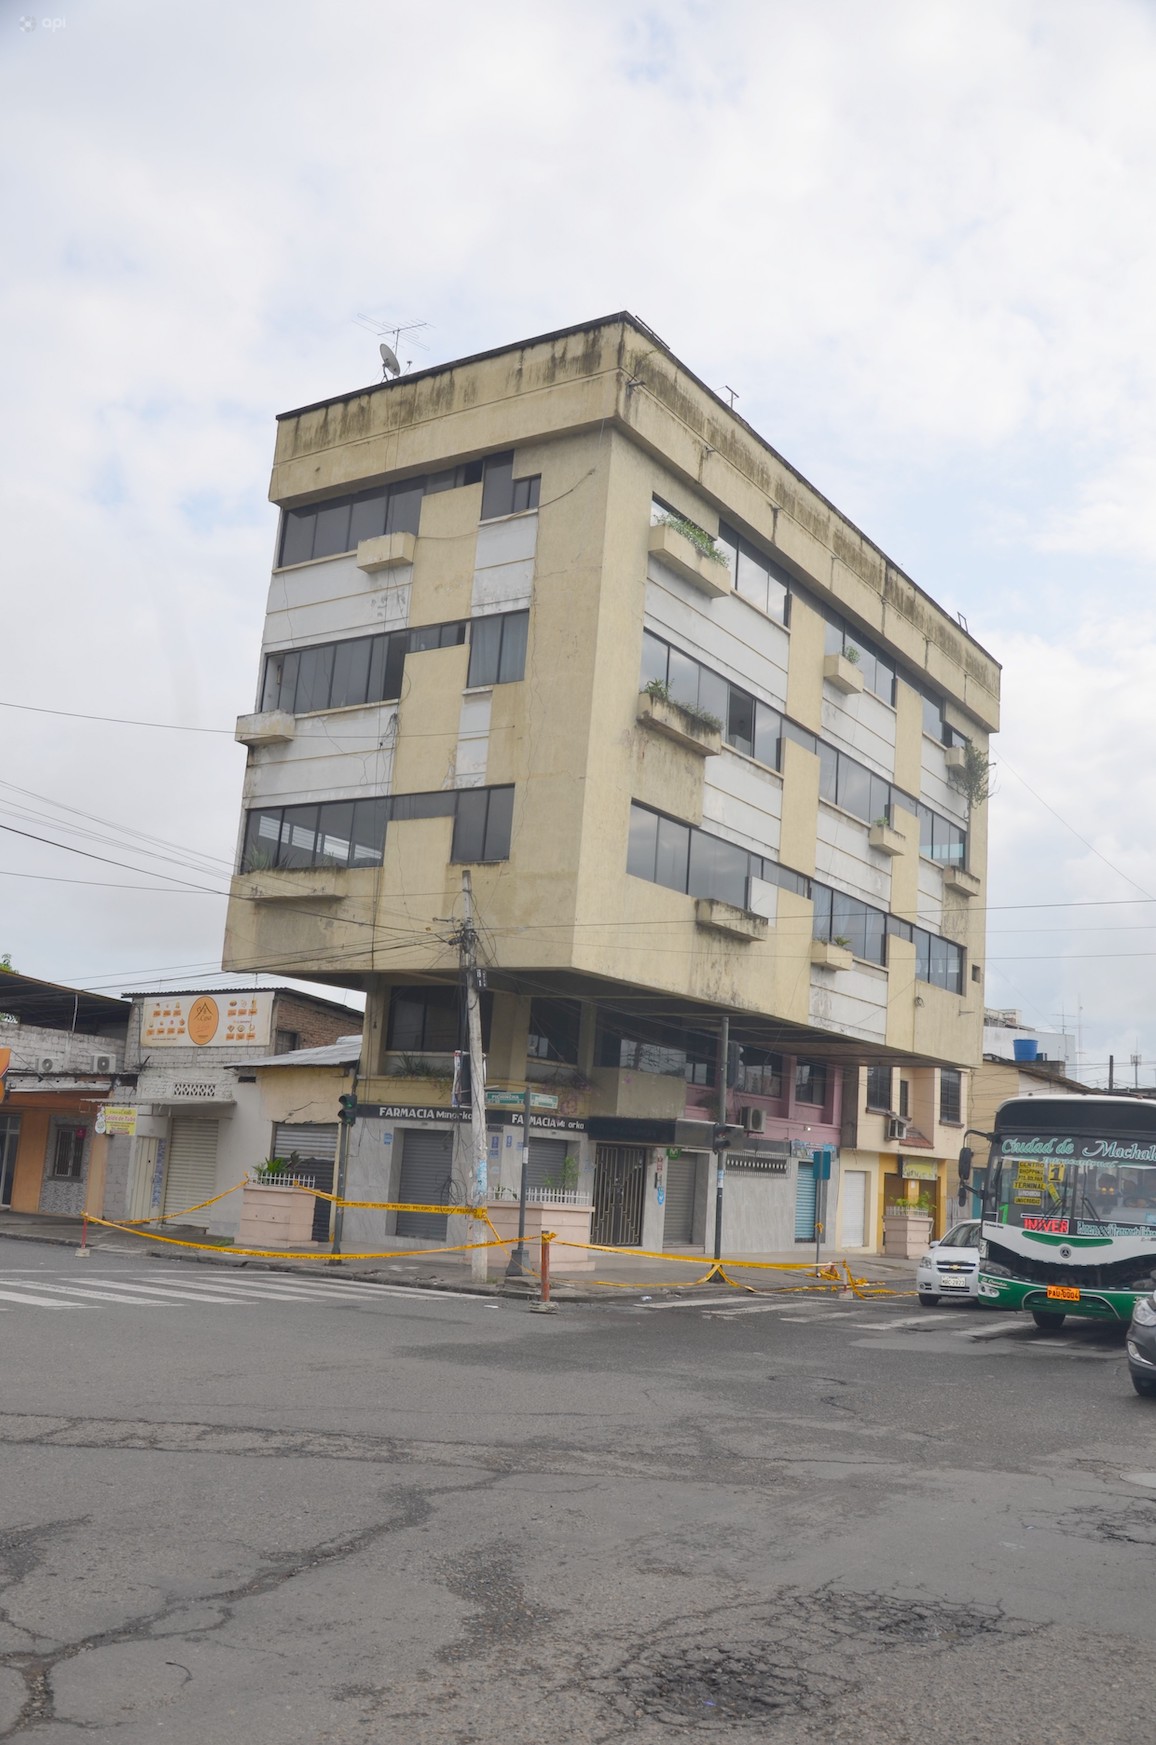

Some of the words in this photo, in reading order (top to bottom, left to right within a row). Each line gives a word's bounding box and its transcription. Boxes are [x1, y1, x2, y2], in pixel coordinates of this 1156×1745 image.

[379, 1107, 435, 1119] FARMACIA
[511, 1113, 557, 1128] FAMACIA
[1001, 1137, 1053, 1155] Ciudad
[1055, 1138, 1075, 1155] de
[1050, 1167, 1061, 1181] 1
[1014, 1182, 1046, 1190] TERMINAL
